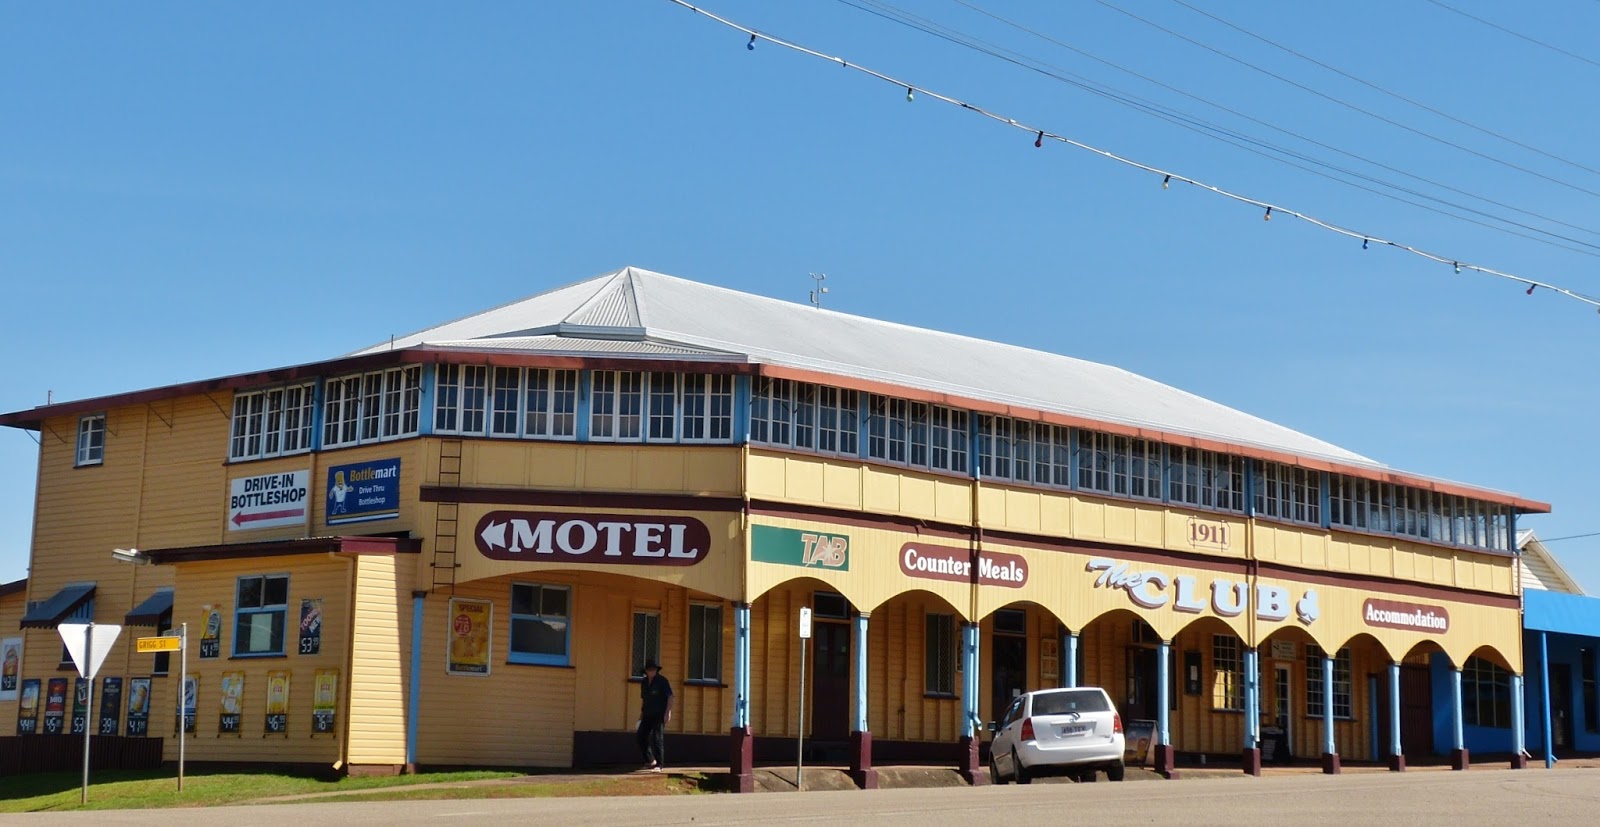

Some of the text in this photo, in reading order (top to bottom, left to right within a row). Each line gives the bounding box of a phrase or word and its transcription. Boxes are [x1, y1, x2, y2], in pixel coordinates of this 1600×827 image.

[244, 473, 294, 493] DRIVE-IN
[350, 465, 397, 483] Bottlemart
[231, 487, 307, 509] BOTTLESHOP
[358, 484, 385, 495] Drive Thru
[358, 496, 386, 507] Bottleshop
[508, 518, 698, 559] MOTEL
[1190, 522, 1228, 545] 1911
[801, 533, 848, 567] TAB
[904, 548, 1024, 582] Counter Meals
[1085, 558, 1292, 622] The CLUB
[458, 603, 484, 613] SPECIAL
[1366, 603, 1447, 630] Accommodation
[139, 640, 167, 649] GRIGG ST
